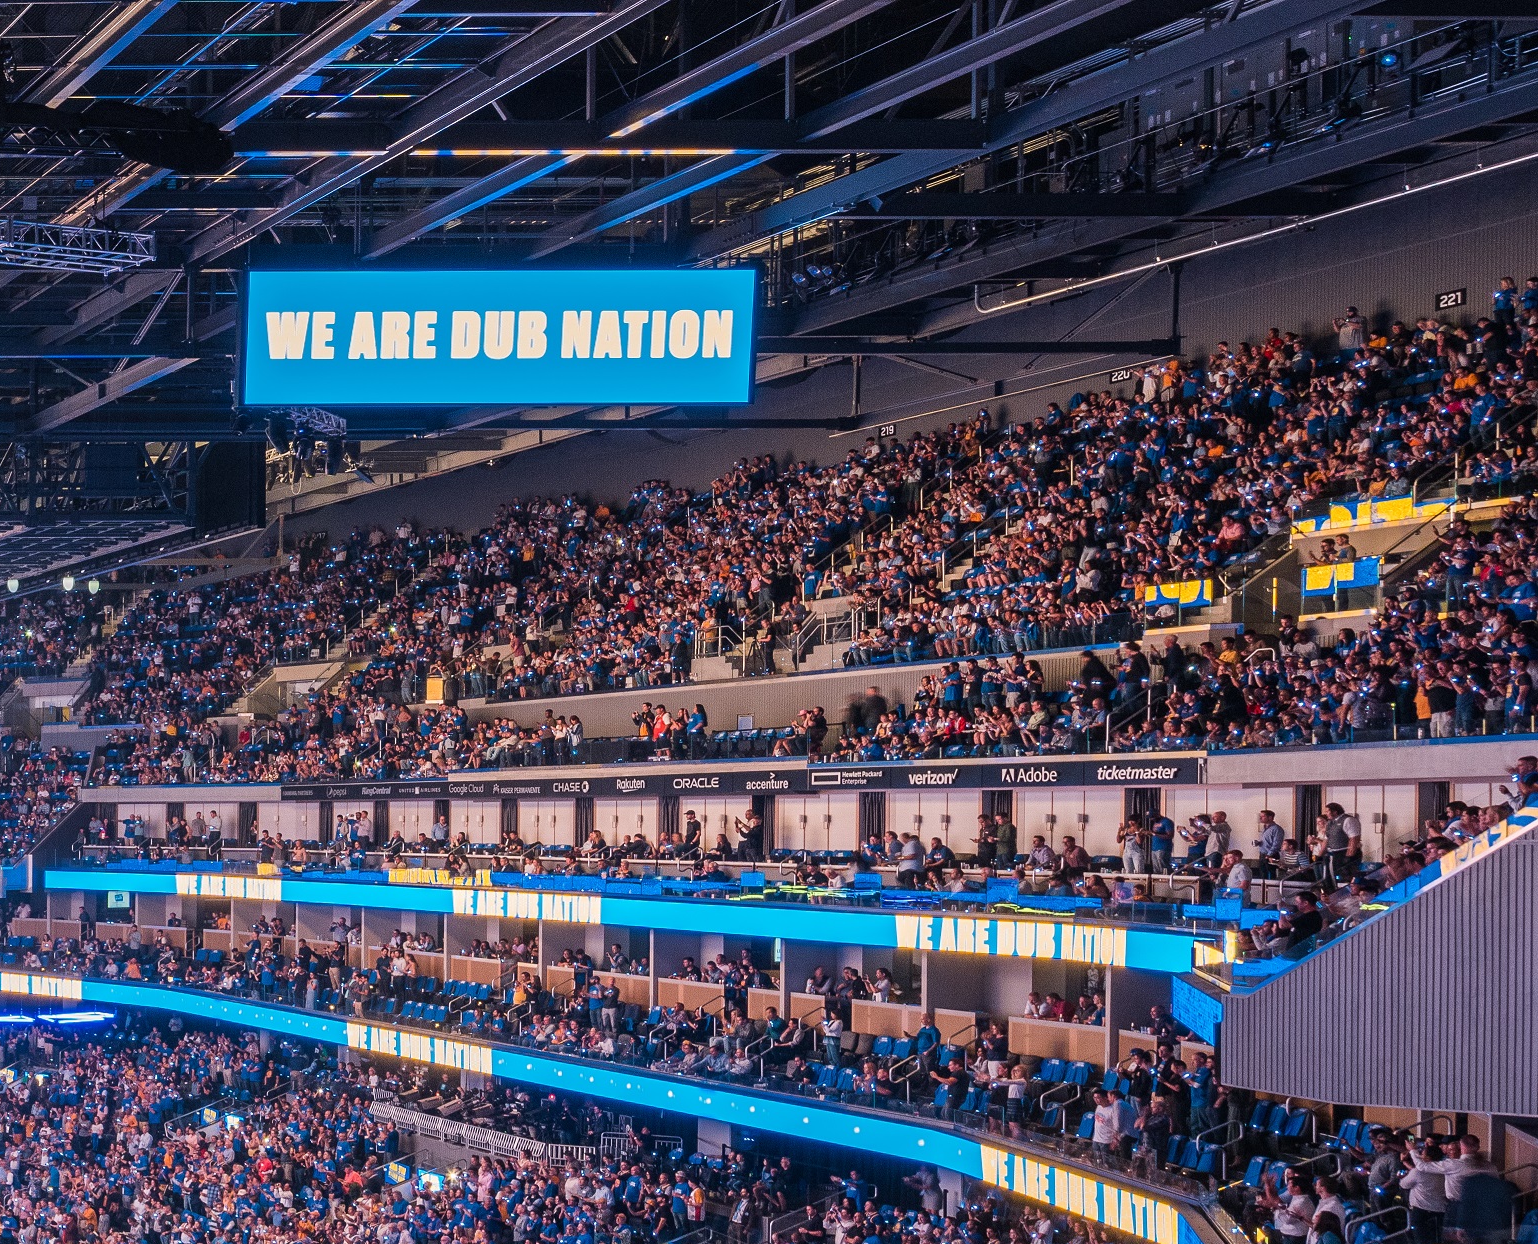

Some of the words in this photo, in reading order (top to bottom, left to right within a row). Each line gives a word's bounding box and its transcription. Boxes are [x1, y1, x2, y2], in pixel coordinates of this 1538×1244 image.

[1439, 292, 1461, 308] 221
[265, 311, 336, 360] WE
[348, 311, 437, 360] ARE
[450, 310, 548, 360] DUB
[561, 309, 734, 359] NATION
[880, 425, 894, 437] 219
[862, 770, 882, 778] Packard
[908, 771, 952, 785] verizon
[1017, 767, 1057, 783] Adobe
[1097, 764, 1178, 781] ticketmaster
[553, 782, 580, 792] CHASE
[616, 778, 645, 790] Rakuten
[673, 777, 719, 789] ORACLE
[746, 779, 789, 790] accenture
[842, 777, 867, 785] Enterprise
[449, 783, 468, 795] Google
[468, 784, 484, 793] Cloud
[896, 914, 932, 950] WE
[939, 916, 989, 954] ARE
[997, 919, 1056, 960] DUB
[1061, 923, 1127, 968] NATION
[981, 1144, 1008, 1192] WE
[1013, 1154, 1049, 1206] ARE
